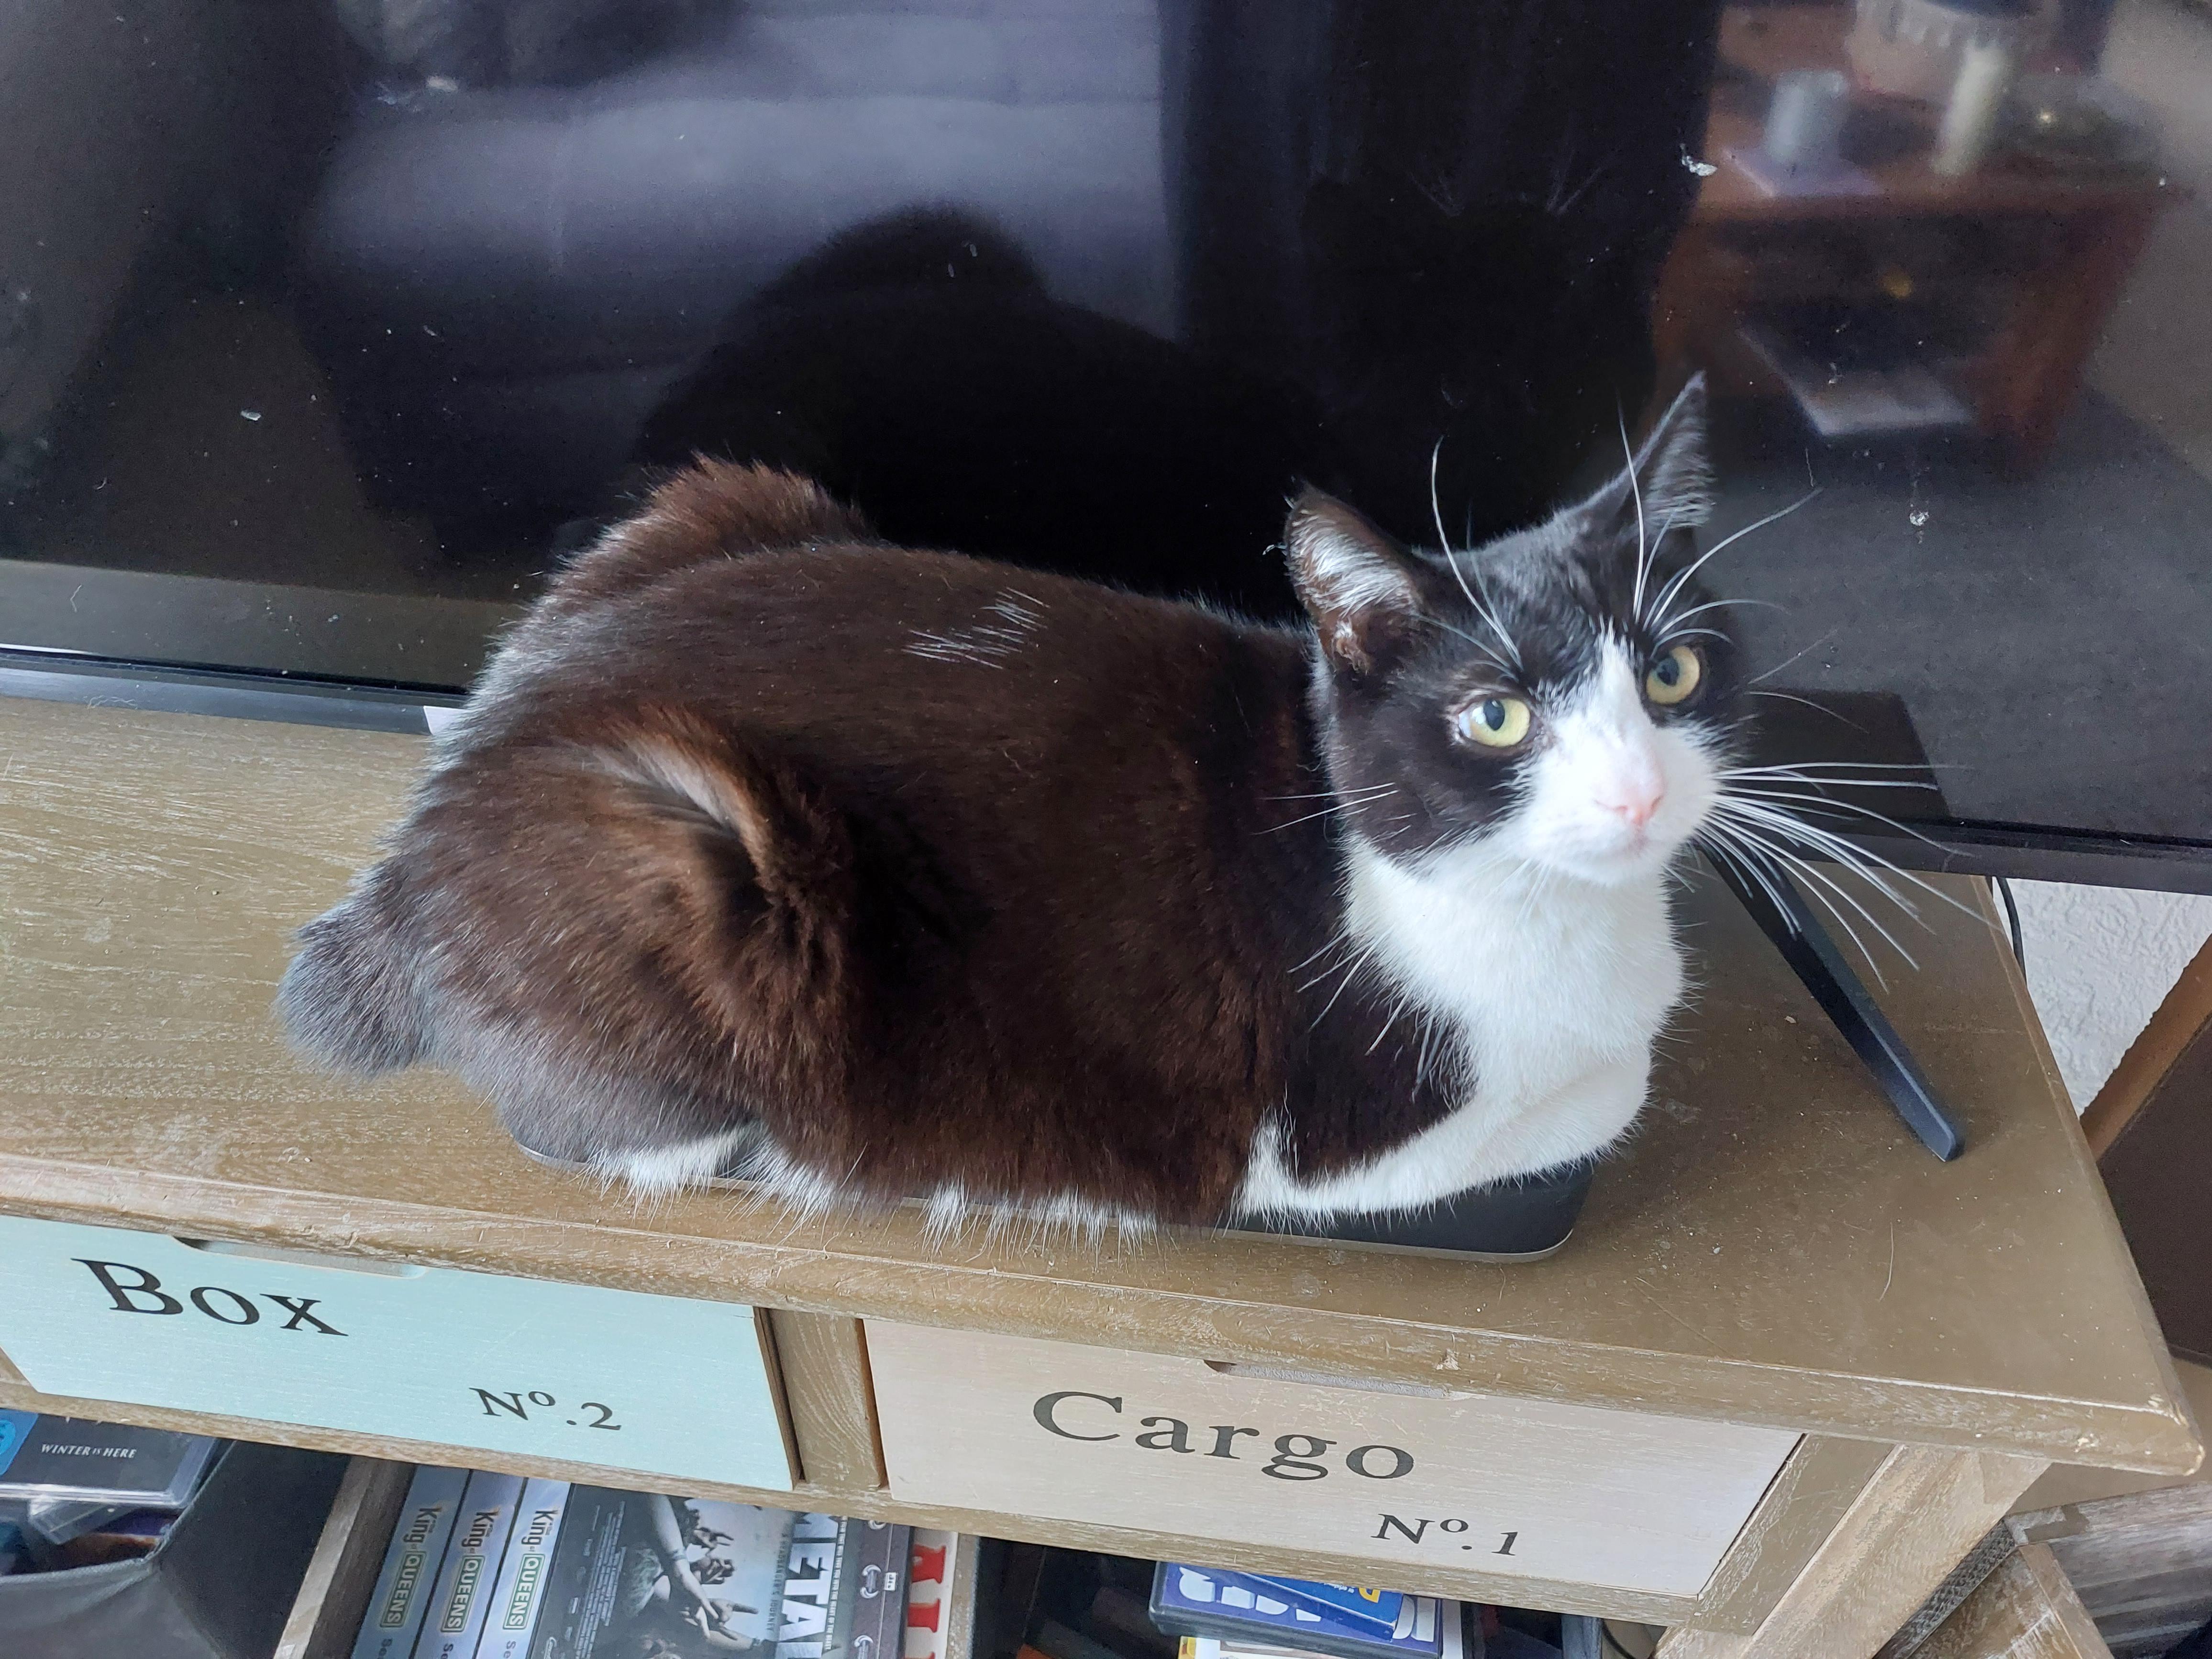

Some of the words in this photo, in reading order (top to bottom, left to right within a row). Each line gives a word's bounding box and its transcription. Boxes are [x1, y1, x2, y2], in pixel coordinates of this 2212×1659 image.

[70, 1258, 349, 1336] Box
[41, 1444, 90, 1456] WINTER
[103, 1448, 137, 1459] HERE
[1033, 1391, 1415, 1481] Cargo
[403, 1507, 442, 1543] King
[462, 1511, 499, 1547] King
[521, 1510, 558, 1545] King
[387, 1556, 420, 1623] QUEENS
[448, 1559, 478, 1627] QUEENS
[509, 1557, 539, 1626] QUEENS
